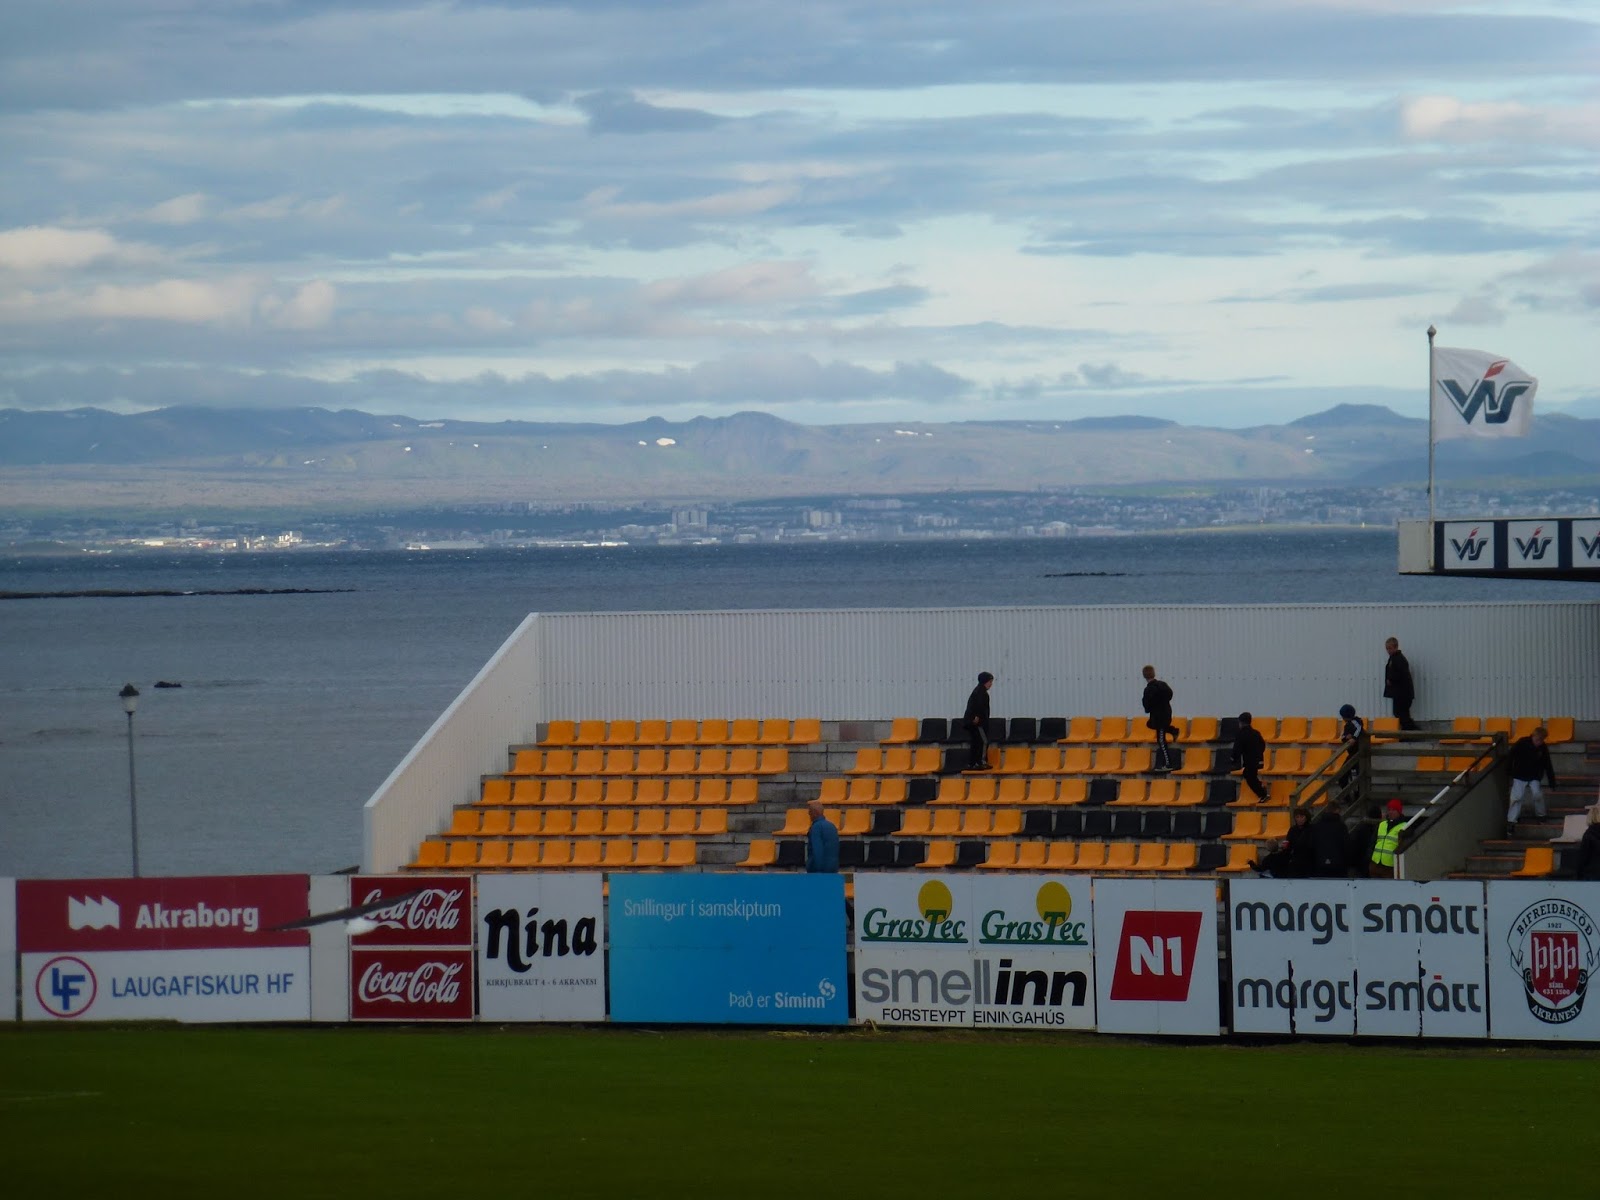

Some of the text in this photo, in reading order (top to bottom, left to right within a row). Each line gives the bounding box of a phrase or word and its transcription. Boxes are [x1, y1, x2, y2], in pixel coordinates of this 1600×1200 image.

[135, 903, 259, 932] Akraborg
[624, 899, 687, 921] Snillingur
[698, 899, 781, 920] samskiptum
[1235, 902, 1349, 944] margt
[1130, 935, 1183, 976] N1
[52, 968, 86, 1010] LF
[112, 973, 294, 998] LAUGAFISKUR HF
[358, 962, 463, 1003] Coca-Cola
[486, 978, 538, 987] KIRKJUBRAUT
[559, 978, 597, 986] AKRANESI
[861, 958, 1088, 1006] smellinn
[729, 991, 826, 1009] Það er Síminn
[1237, 978, 1352, 1022] margt
[1532, 1004, 1580, 1021] AKRANESI
[882, 1008, 966, 1023] FORSTEYPT
